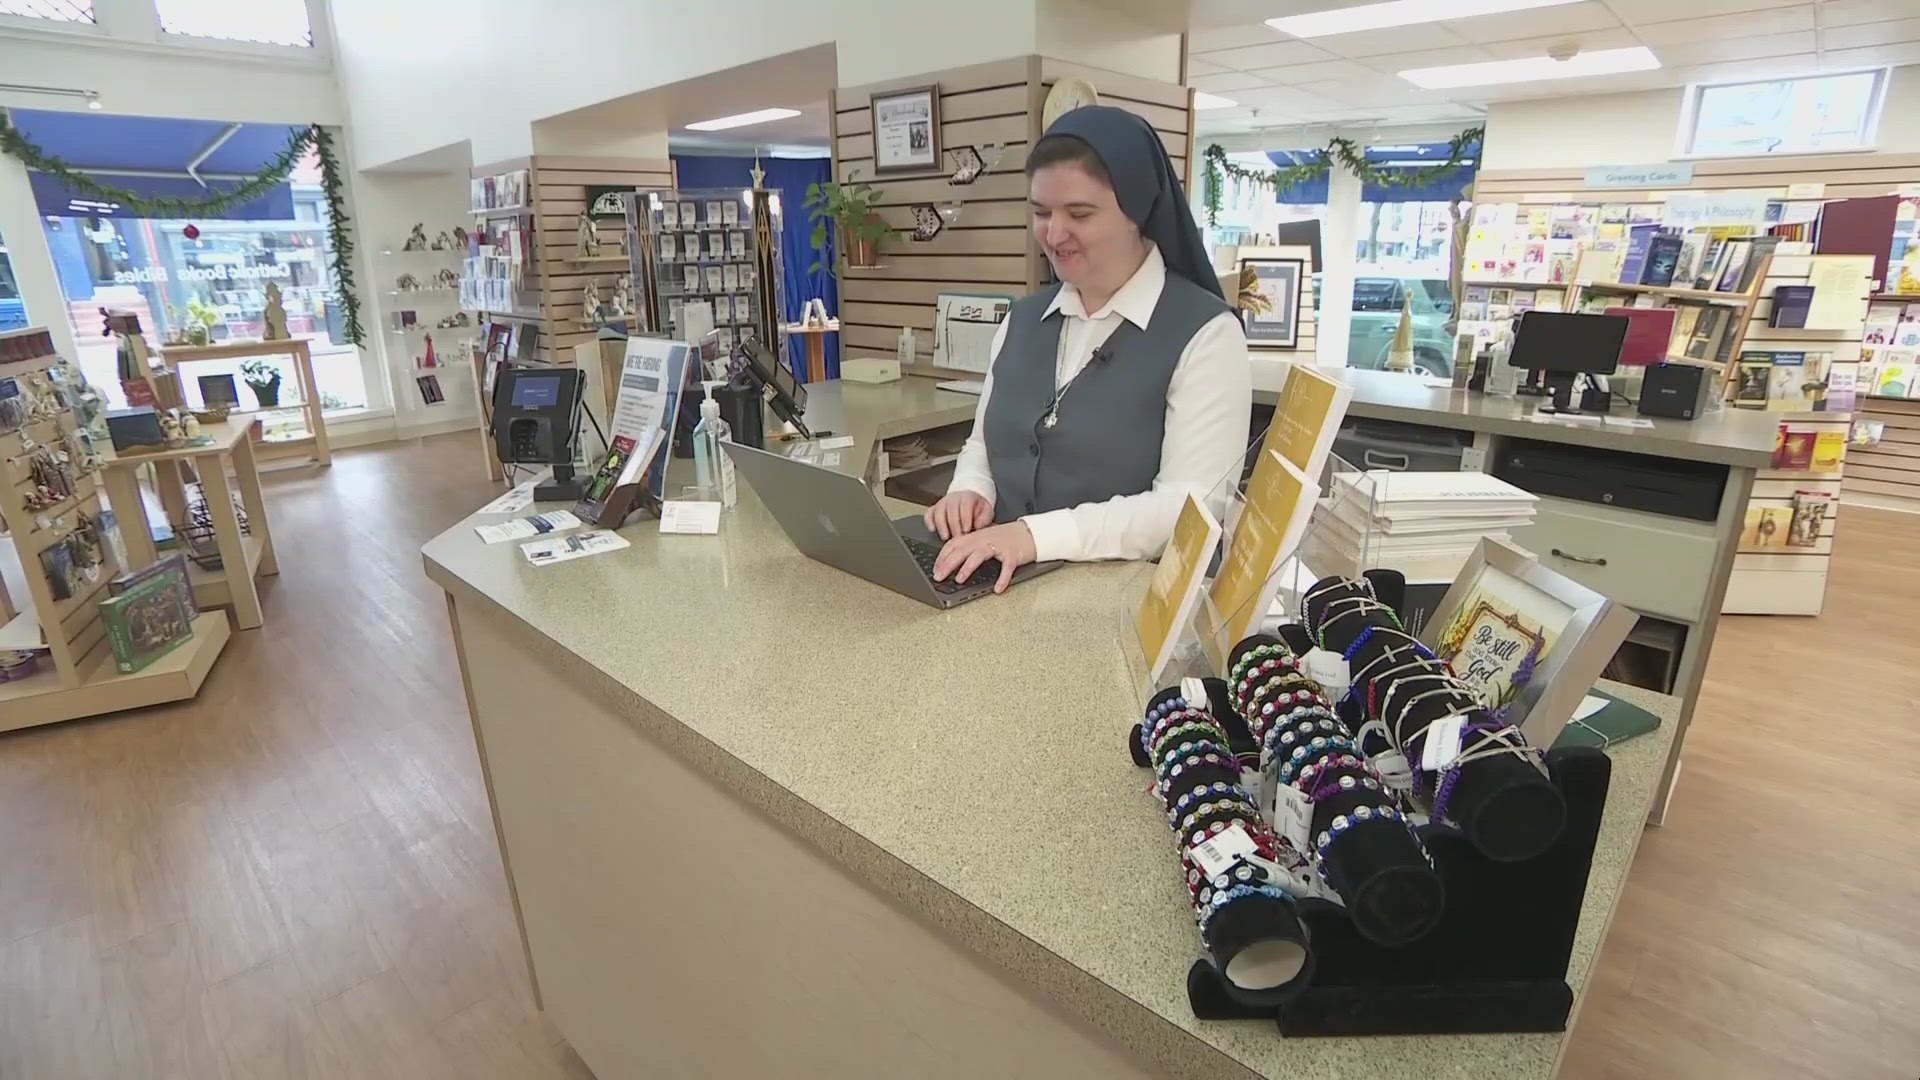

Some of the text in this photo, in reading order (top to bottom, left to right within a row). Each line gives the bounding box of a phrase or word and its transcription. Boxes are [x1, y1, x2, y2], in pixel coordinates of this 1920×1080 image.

[1606, 172, 1678, 184] Greeting Cards
[1473, 625, 1521, 661] Be still
[1458, 659, 1503, 685] God
